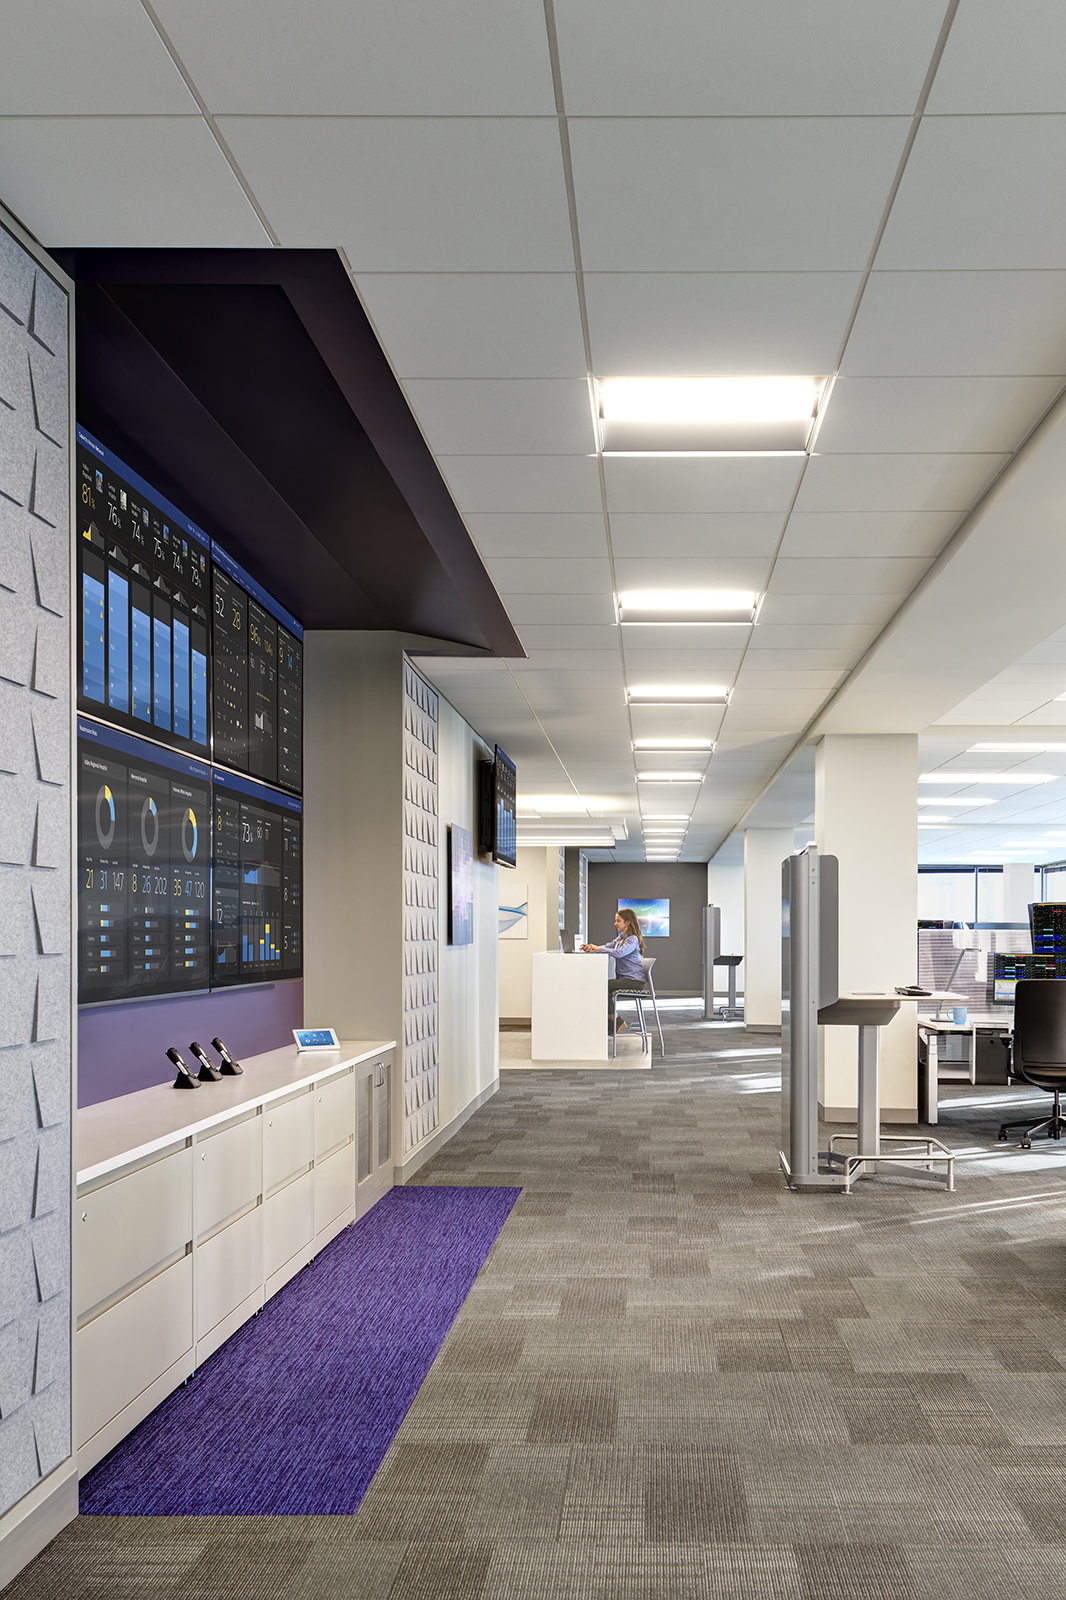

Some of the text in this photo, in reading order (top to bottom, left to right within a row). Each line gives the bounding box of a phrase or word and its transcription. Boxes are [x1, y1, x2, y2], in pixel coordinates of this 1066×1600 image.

[82, 483, 96, 510] 81%
[107, 502, 121, 528] 76%
[131, 520, 144, 546] 74%
[153, 537, 165, 561] 75%
[172, 551, 183, 574] 74%
[191, 566, 201, 588] 79%
[215, 594, 224, 617] 52
[232, 608, 241, 630] 28
[250, 623, 261, 647] 96%
[217, 815, 222, 831] 8
[242, 822, 253, 843] 73%
[85, 868, 124, 891] 21 31 147
[131, 874, 167, 895] 8 26 202
[174, 878, 205, 898] 35 47 120
[217, 908, 223, 924] 12
